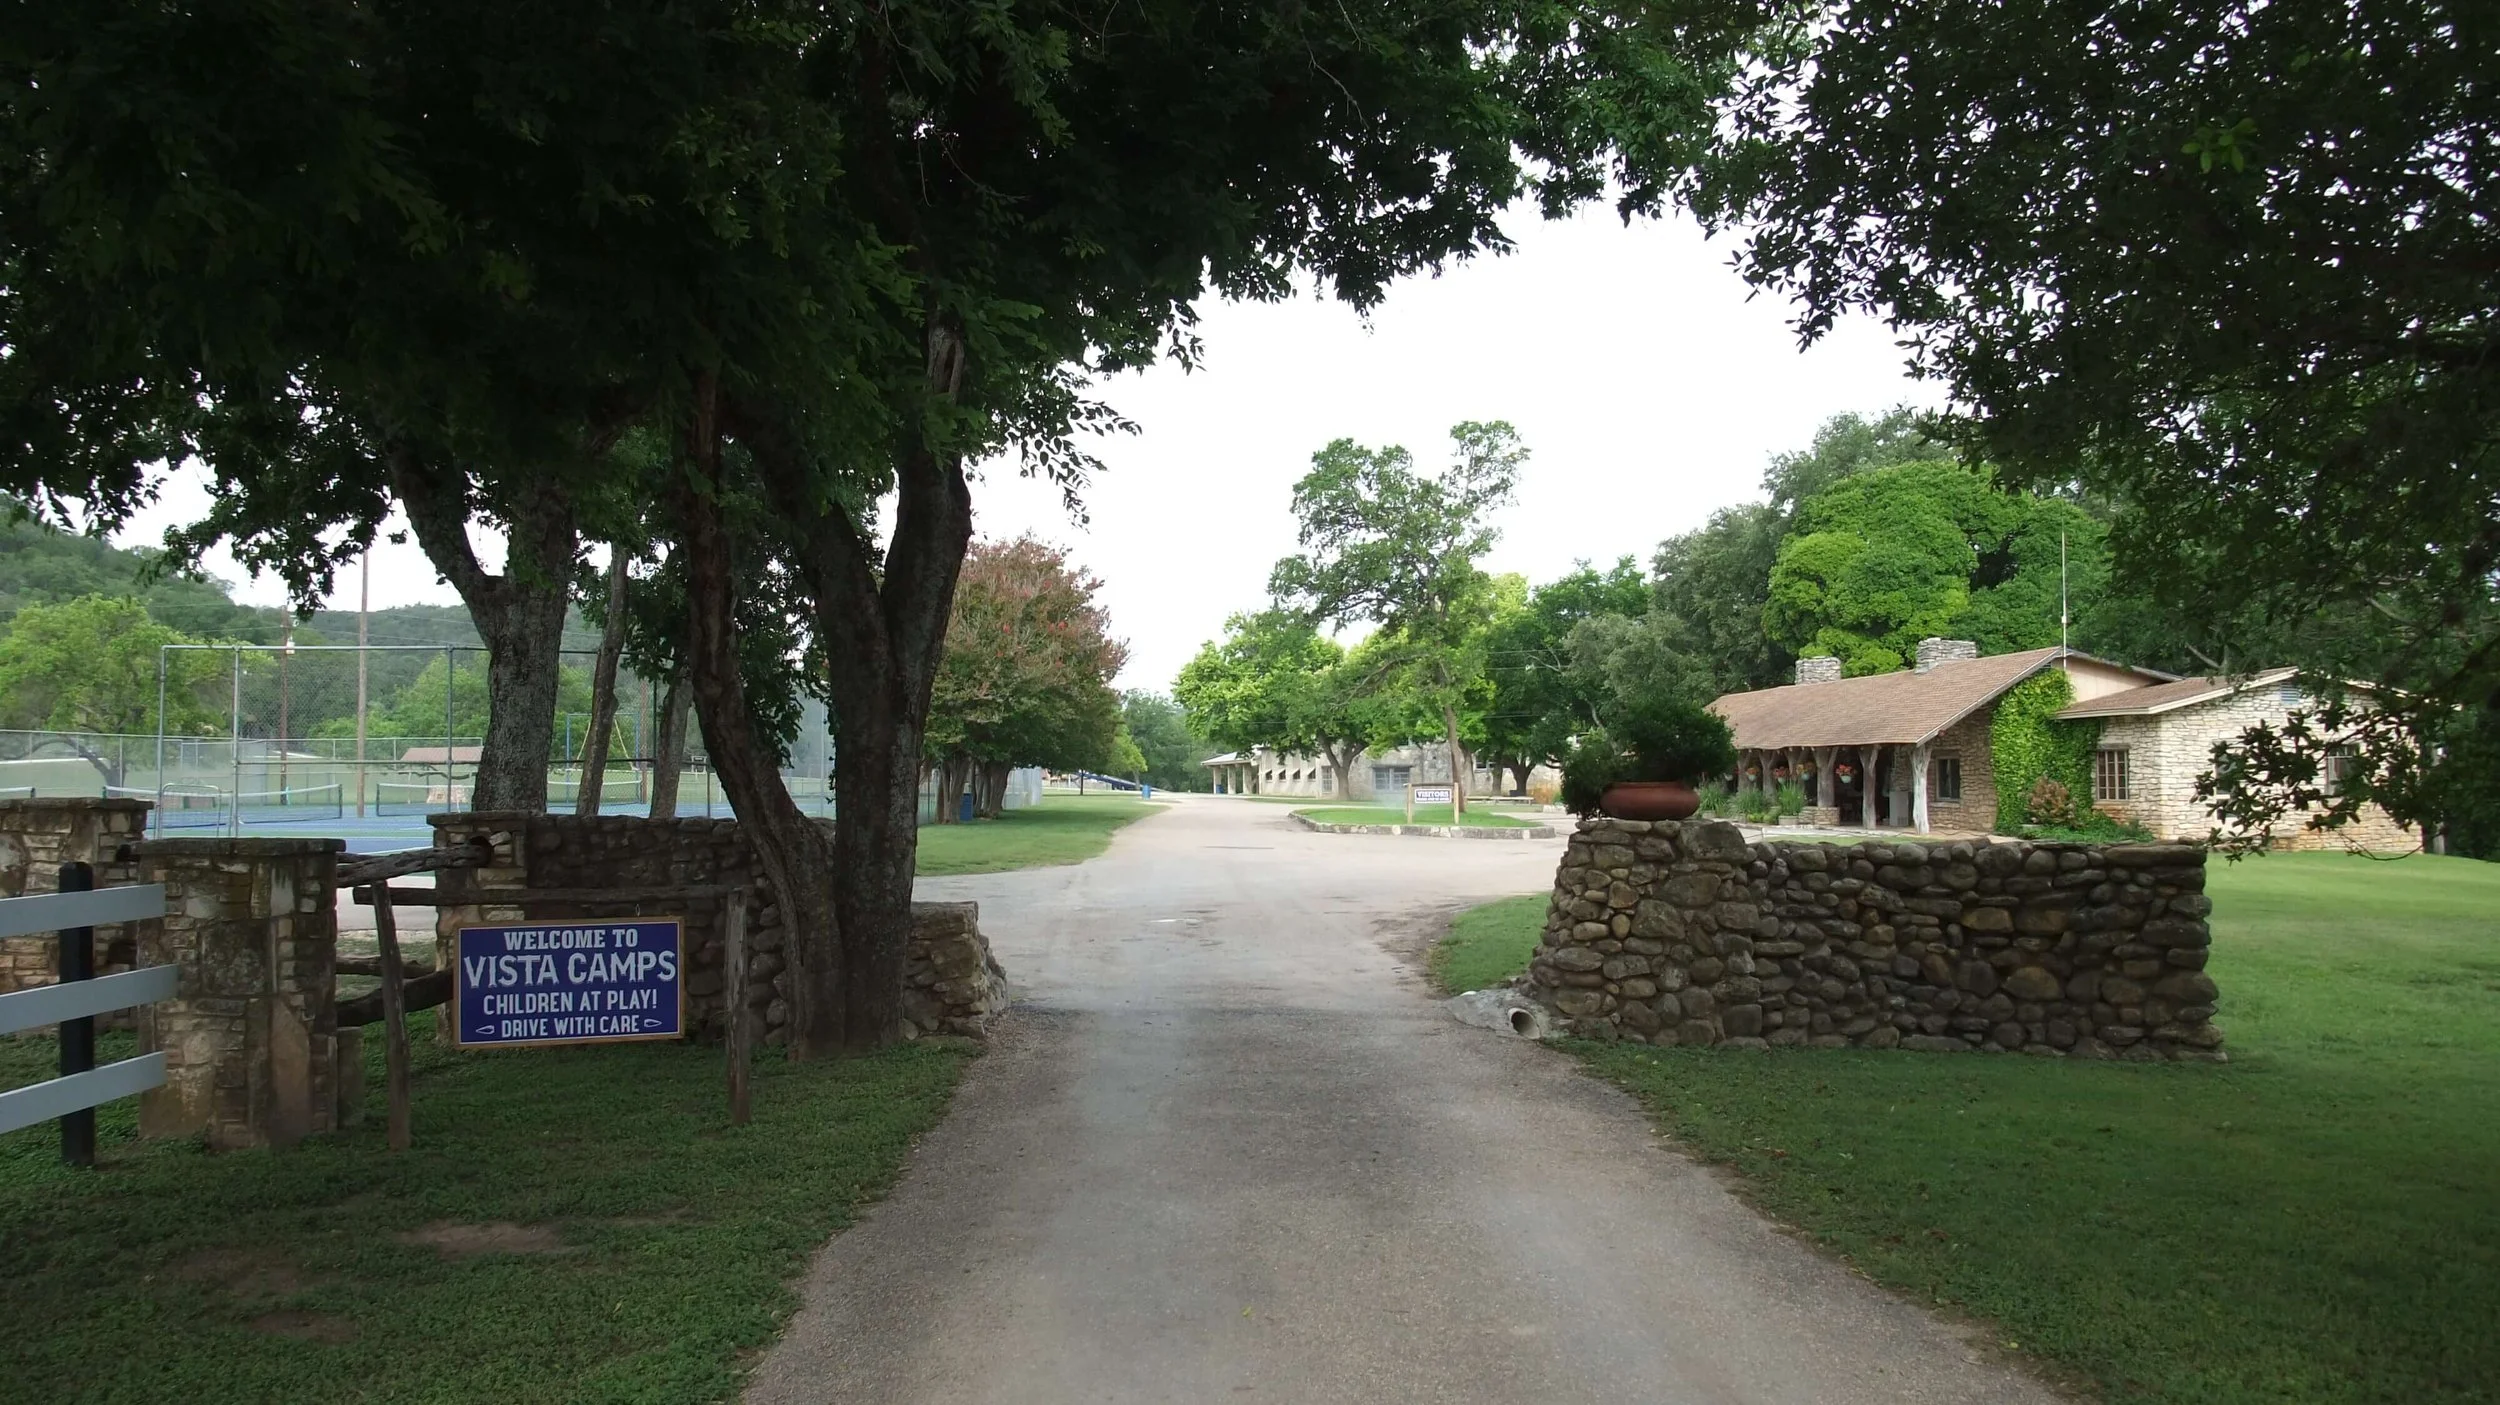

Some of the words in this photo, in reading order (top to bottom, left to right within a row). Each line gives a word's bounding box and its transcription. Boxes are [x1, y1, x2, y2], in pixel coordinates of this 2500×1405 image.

[504, 929, 606, 951] WELCOME
[612, 928, 638, 948] TO
[464, 954, 559, 989] VISTA
[568, 951, 676, 985] CAMPS
[483, 992, 573, 1015] CHILDREN
[579, 991, 601, 1011] AT
[607, 989, 657, 1010] PLAY!
[501, 1019, 549, 1038] DRIVE
[554, 1017, 595, 1035] WITH
[600, 1015, 640, 1034] CARE
